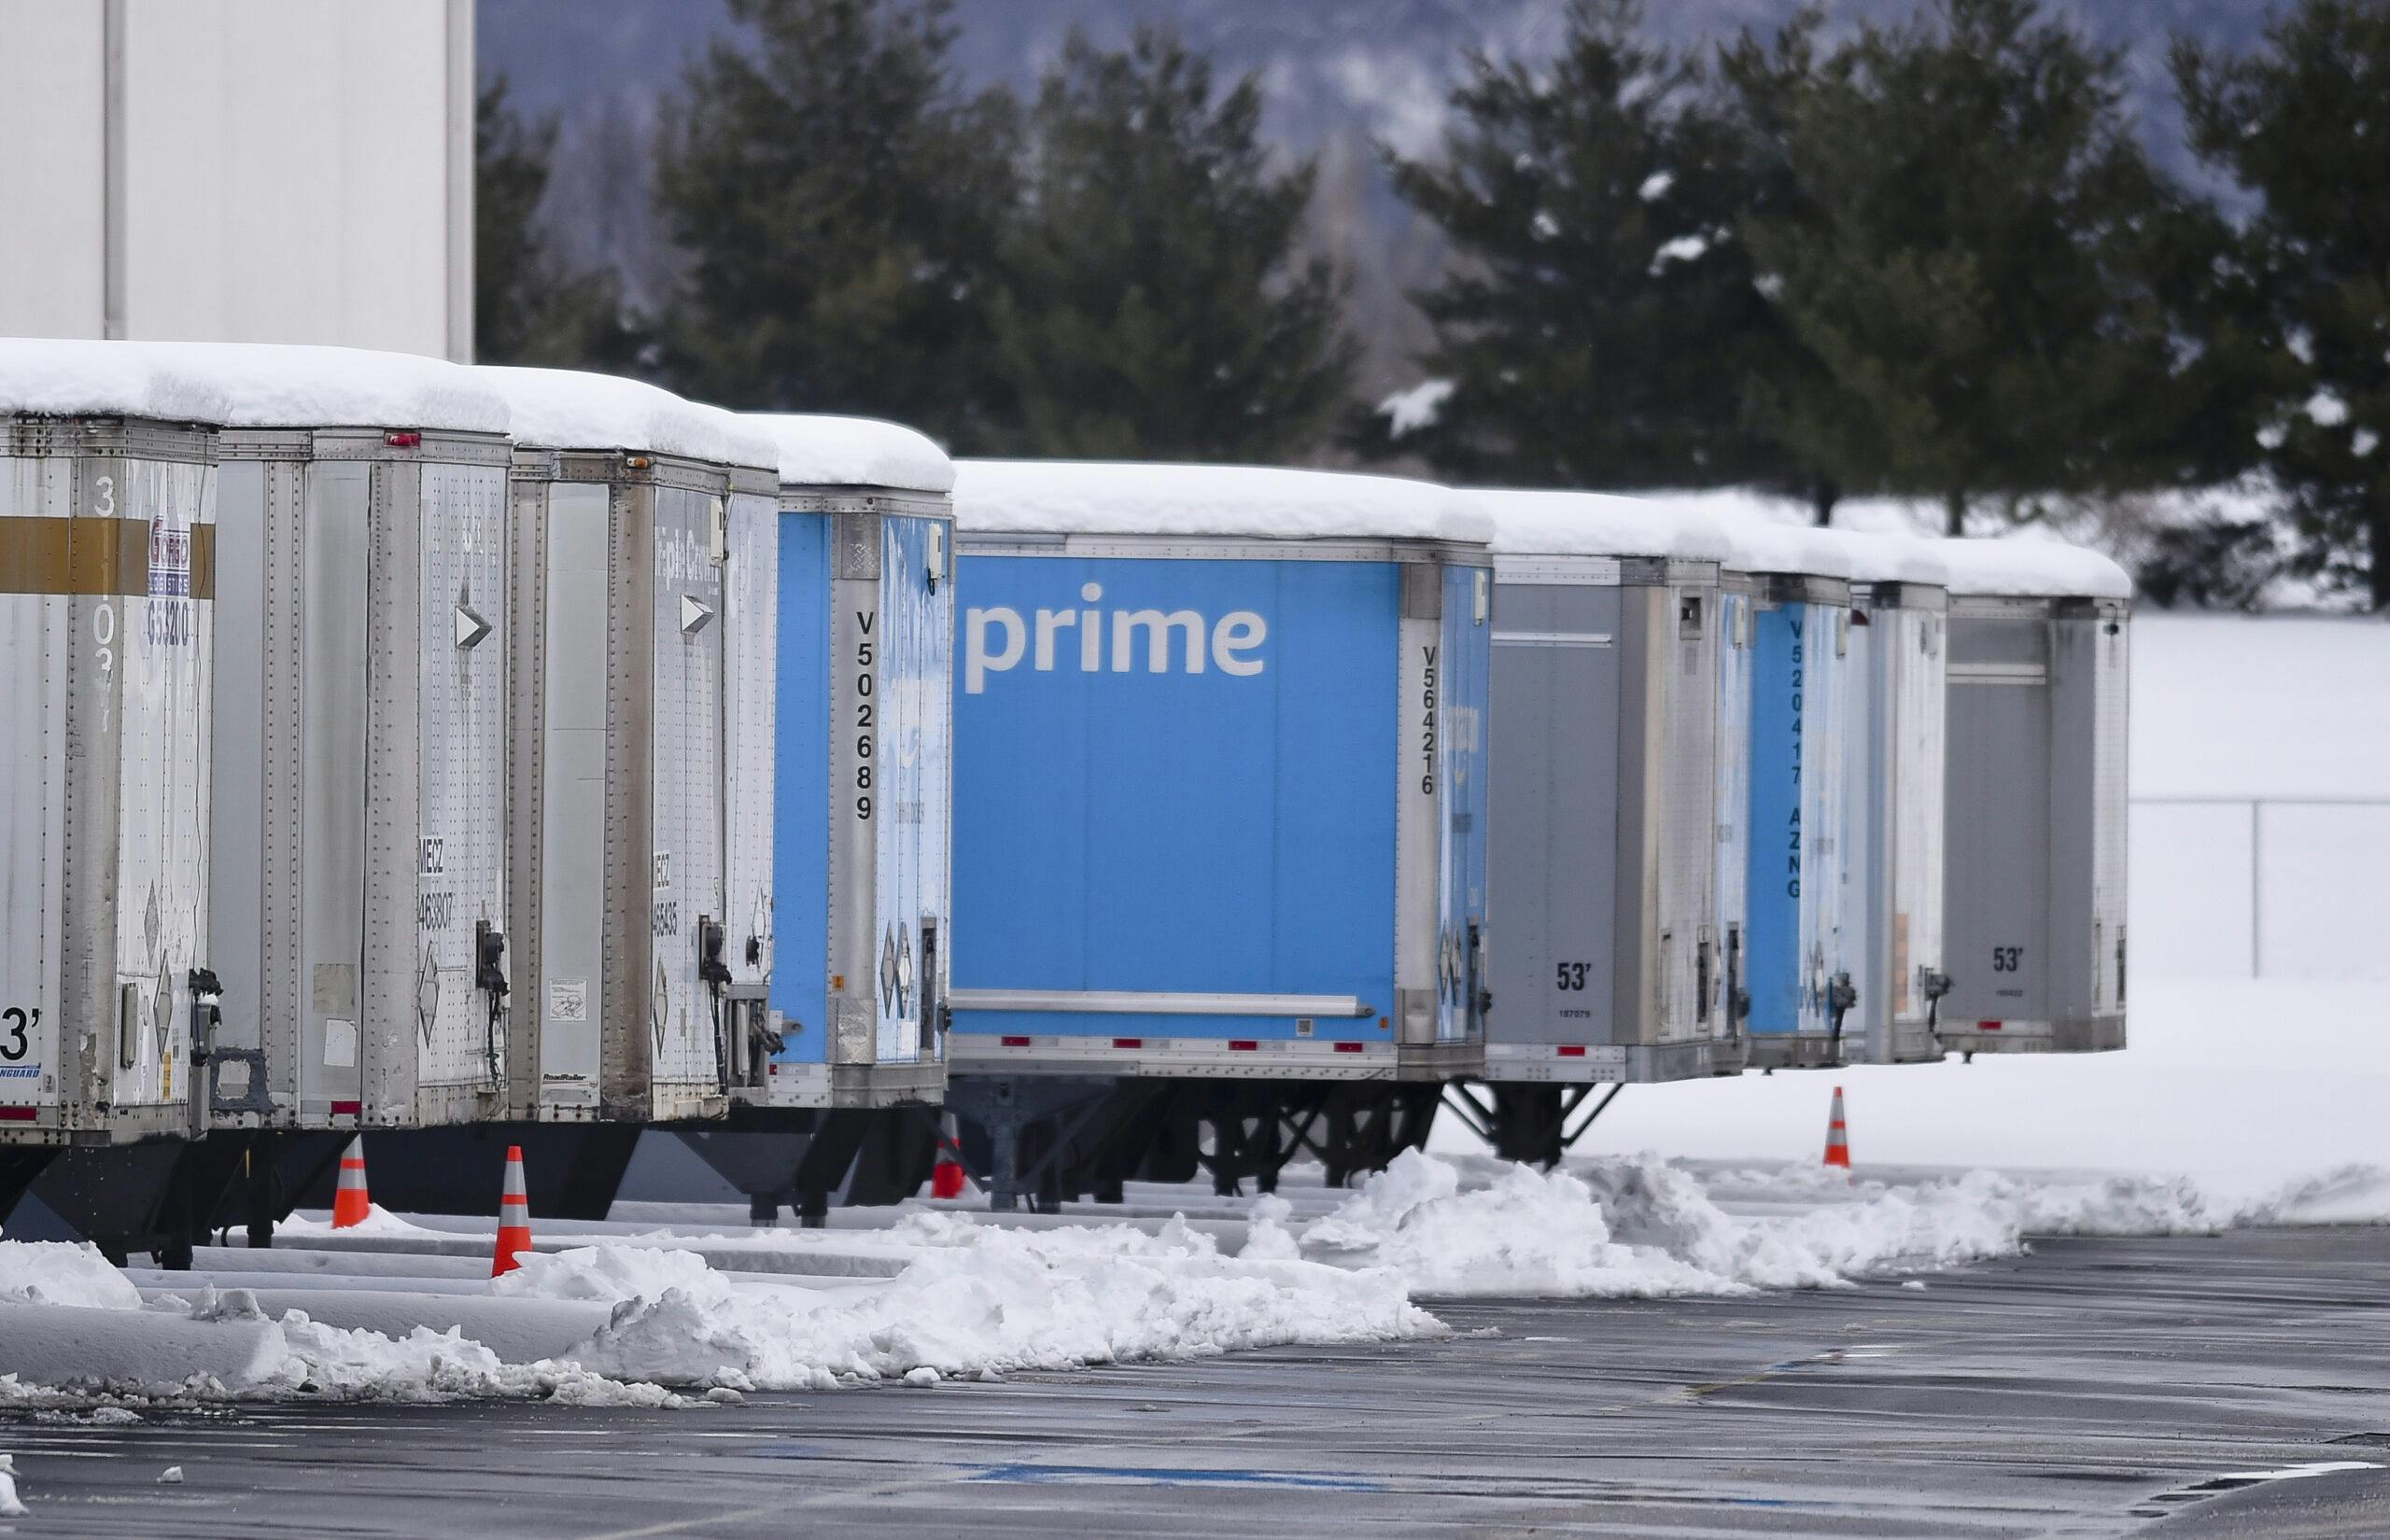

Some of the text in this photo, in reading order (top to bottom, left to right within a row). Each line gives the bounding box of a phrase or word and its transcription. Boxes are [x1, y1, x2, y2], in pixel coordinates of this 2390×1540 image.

[93, 476, 115, 732] 31103
[964, 582, 1267, 694] prime
[856, 611, 874, 820] V502689
[1422, 646, 1436, 795] V564216
[1787, 621, 1803, 898] V520417 AZNG
[654, 853, 669, 888] ECZ
[1557, 962, 1591, 990] 53'
[1994, 947, 2023, 972] 53'
